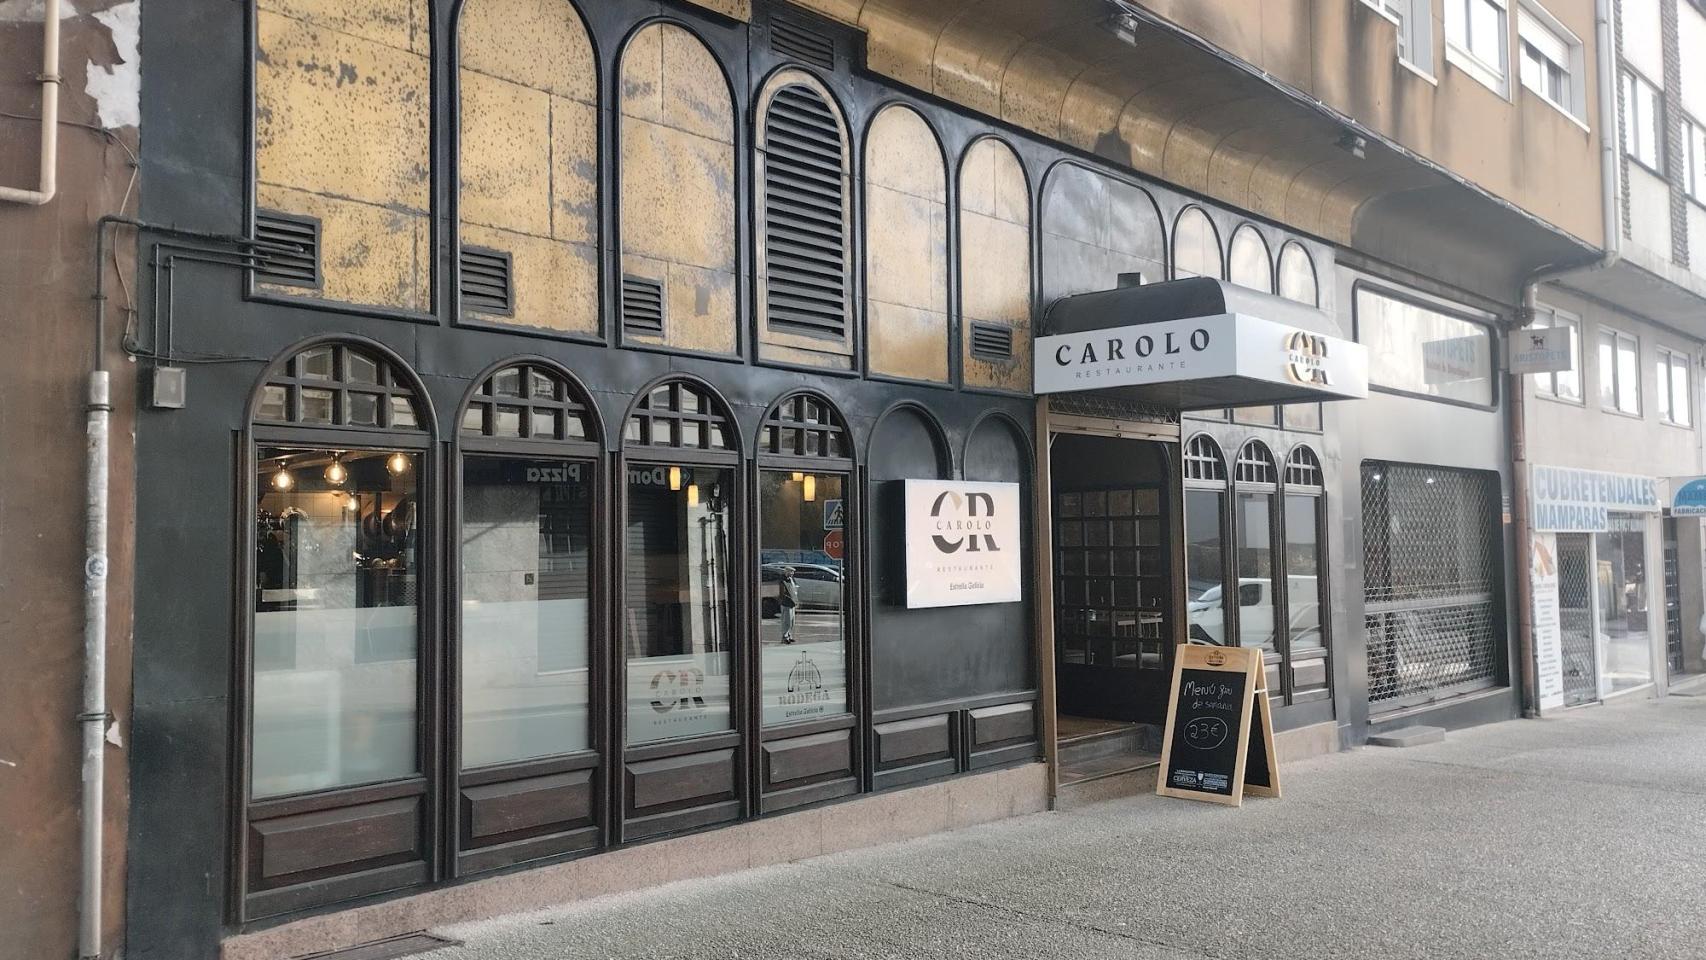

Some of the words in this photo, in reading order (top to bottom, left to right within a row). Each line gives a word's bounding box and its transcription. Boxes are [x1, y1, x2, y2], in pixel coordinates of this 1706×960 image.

[1055, 328, 1210, 367] CAROLO
[1076, 361, 1186, 379] RESTAURANTE
[1535, 467, 1657, 506] CUBRETENDALES
[930, 491, 1001, 554] CR
[1537, 503, 1607, 530] MAMPARAS
[936, 520, 992, 531] CAROLO
[936, 564, 994, 573] RESTAURANTE
[1184, 681, 1216, 697] Menú
[779, 691, 831, 705] BODEGA
[1189, 723, 1220, 740] 23€
